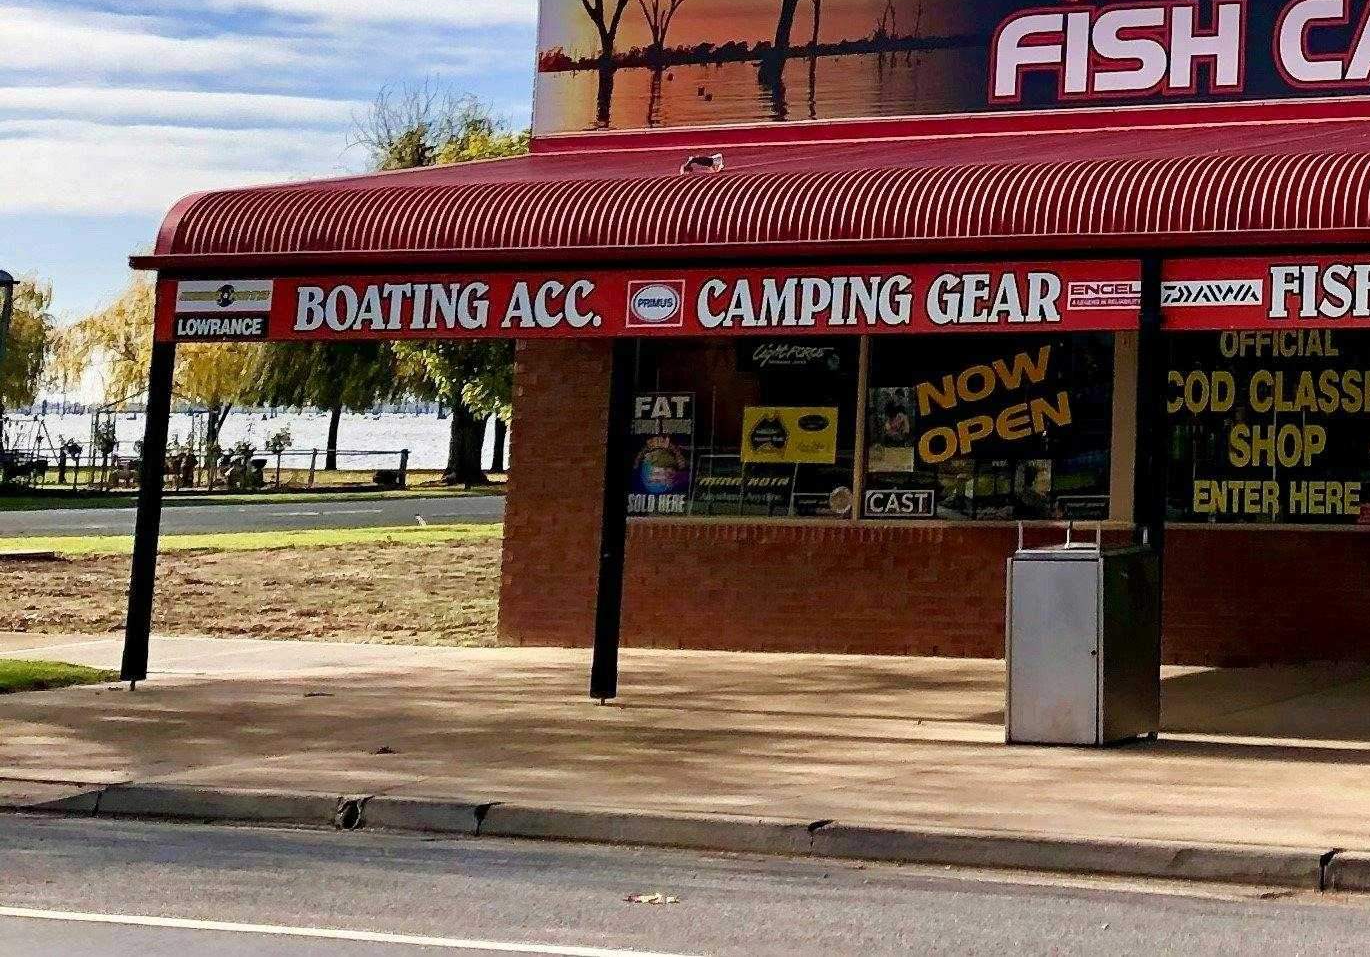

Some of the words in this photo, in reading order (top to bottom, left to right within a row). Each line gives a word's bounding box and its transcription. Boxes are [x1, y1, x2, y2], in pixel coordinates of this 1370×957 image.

[995, 6, 1239, 96] FISH
[294, 282, 489, 331] BOATING
[502, 279, 601, 328] ACC.
[637, 298, 673, 308] PRIMUS
[697, 275, 912, 328] CAMPING
[927, 272, 1062, 323] GEAR
[1070, 283, 1141, 296] ENGEL
[177, 318, 262, 335] LOWRANCE
[1220, 330, 1339, 357] OFFICIAL
[917, 345, 1051, 416] NOW
[1168, 370, 1235, 413] COD
[635, 396, 690, 418] FAT
[919, 391, 1072, 463] OPEN
[1230, 423, 1326, 467] SHOP
[627, 493, 655, 514] SOLD
[658, 493, 686, 513] HERE
[869, 493, 928, 513] CAST
[1193, 480, 1279, 513] ENTER
[1290, 481, 1361, 514] HERE
